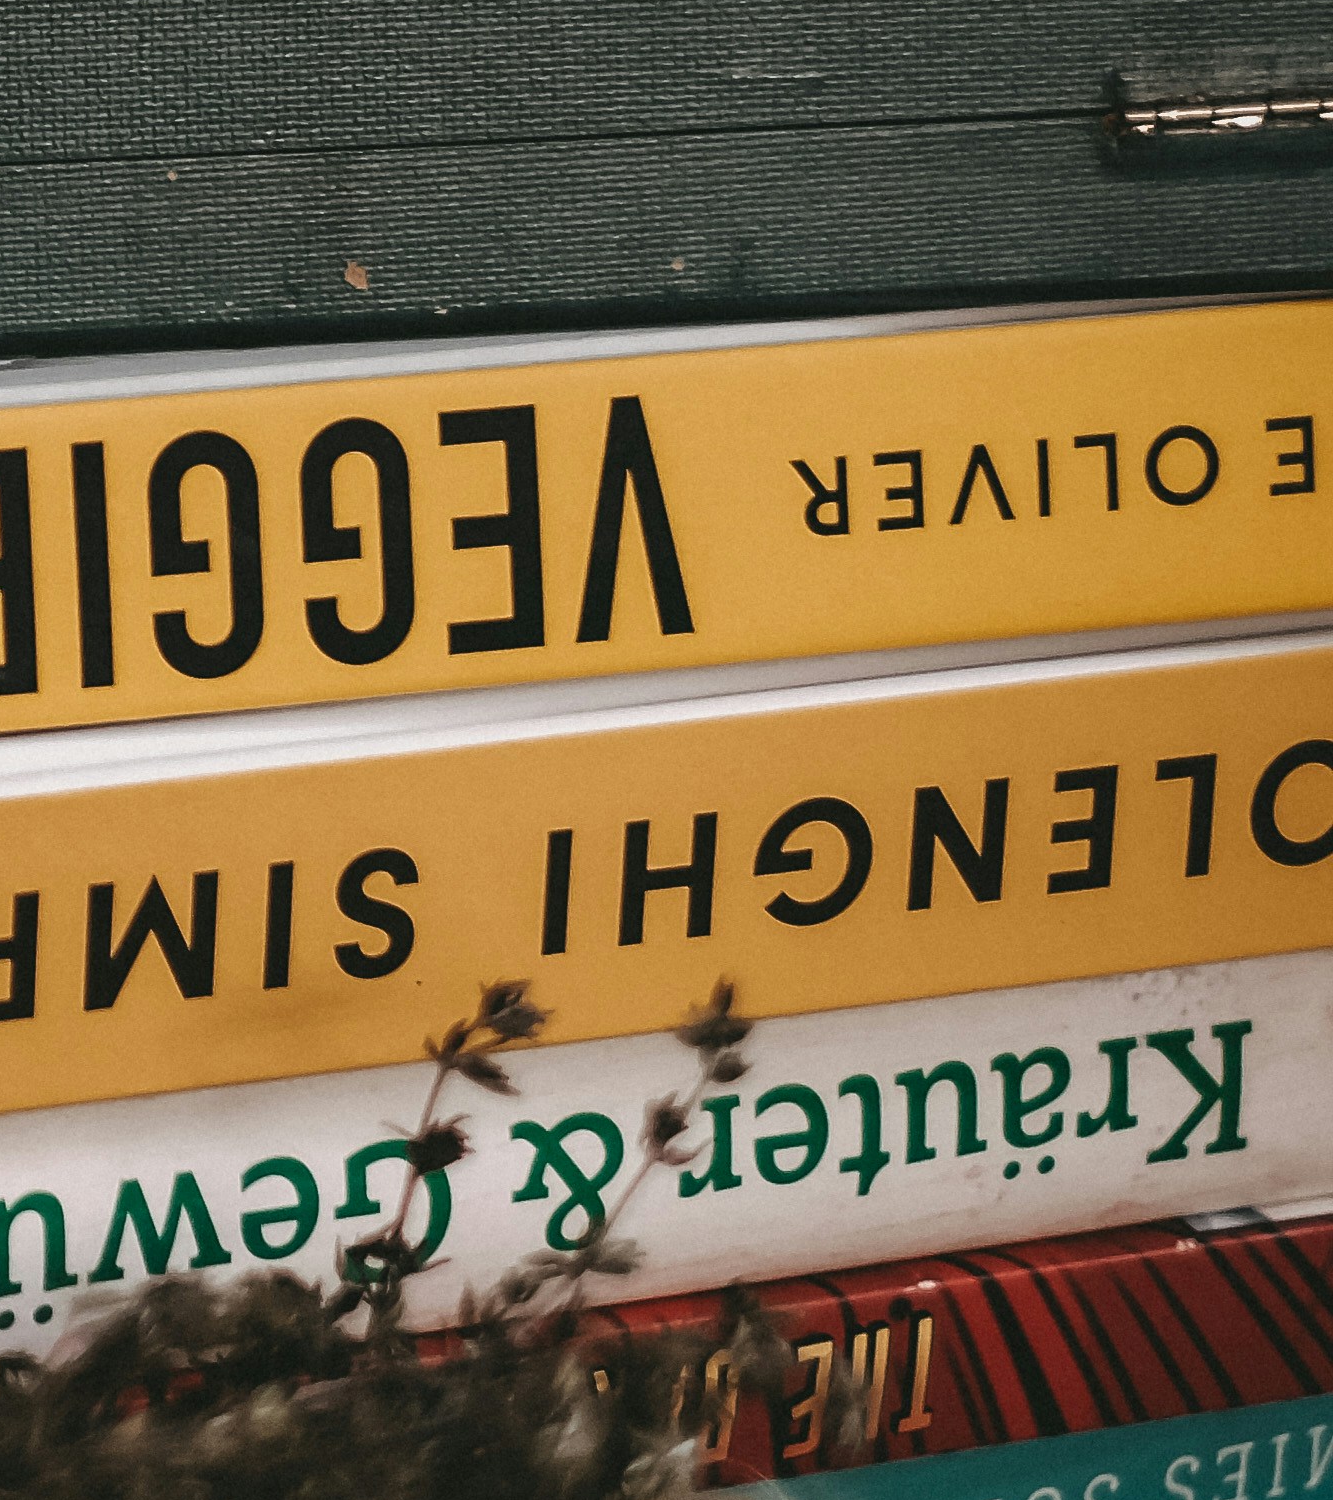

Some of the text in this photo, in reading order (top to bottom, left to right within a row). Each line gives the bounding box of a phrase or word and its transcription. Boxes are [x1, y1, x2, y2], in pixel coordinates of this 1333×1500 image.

[788, 423, 1221, 537] OLIVER
[540, 737, 1333, 956] OLENGHI
[510, 1111, 625, 1252] &
[677, 1019, 1254, 1198] Kräuter
